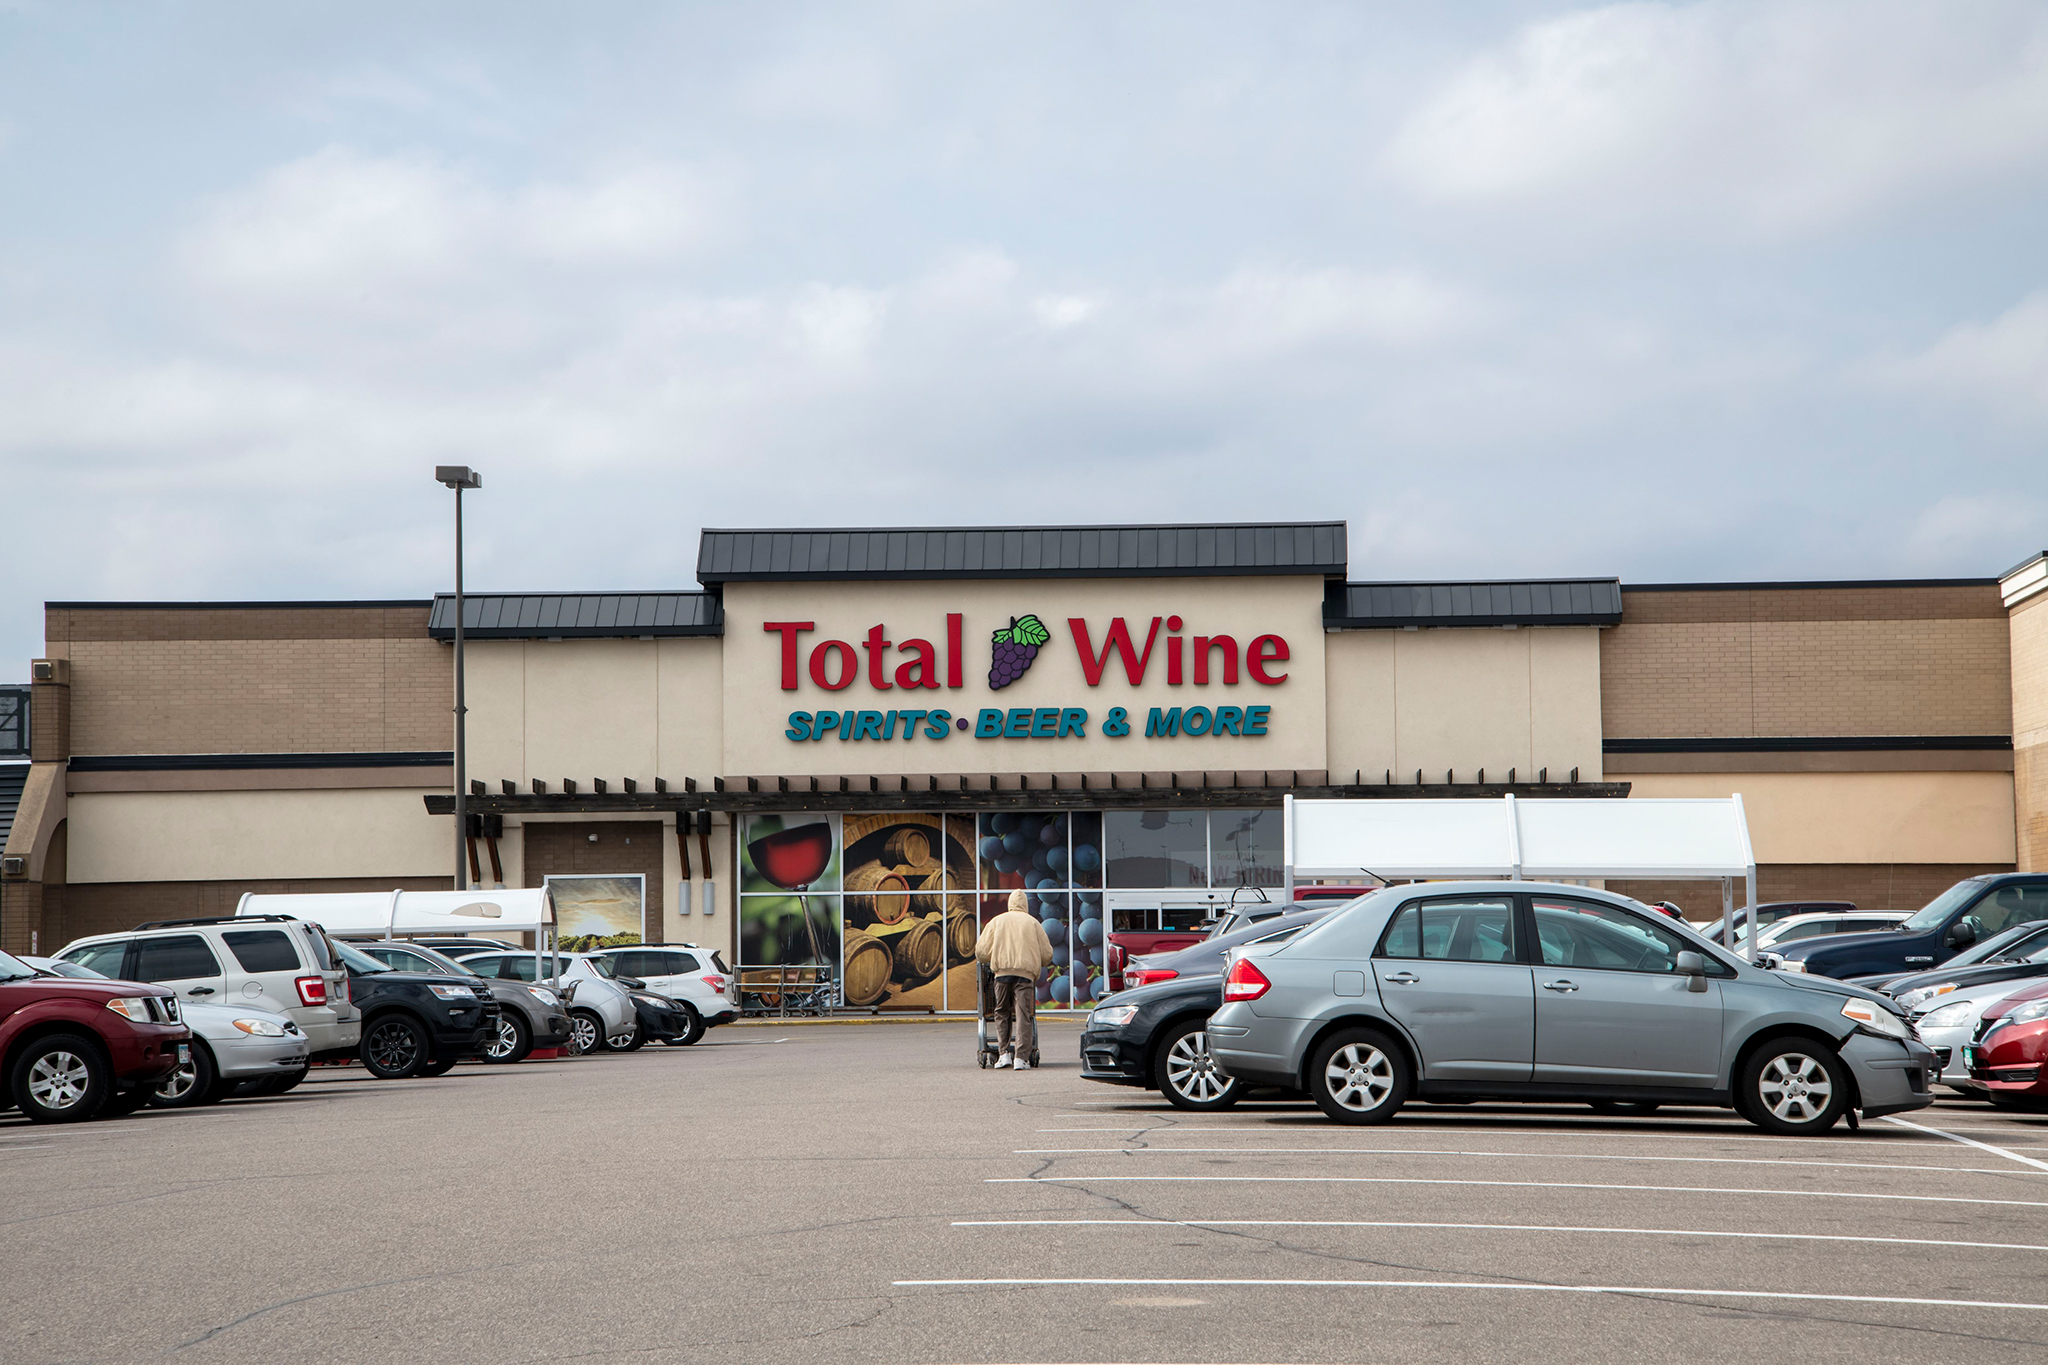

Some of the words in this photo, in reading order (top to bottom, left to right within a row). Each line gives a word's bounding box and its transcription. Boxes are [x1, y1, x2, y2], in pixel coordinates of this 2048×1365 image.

[763, 612, 964, 691] Total
[1067, 615, 1291, 686] Wine
[785, 709, 951, 741] SPIRITS
[975, 707, 1087, 738] BEER
[1102, 706, 1130, 737] &
[1145, 705, 1271, 738] MORE
[1236, 865, 1285, 884] HIRIN
